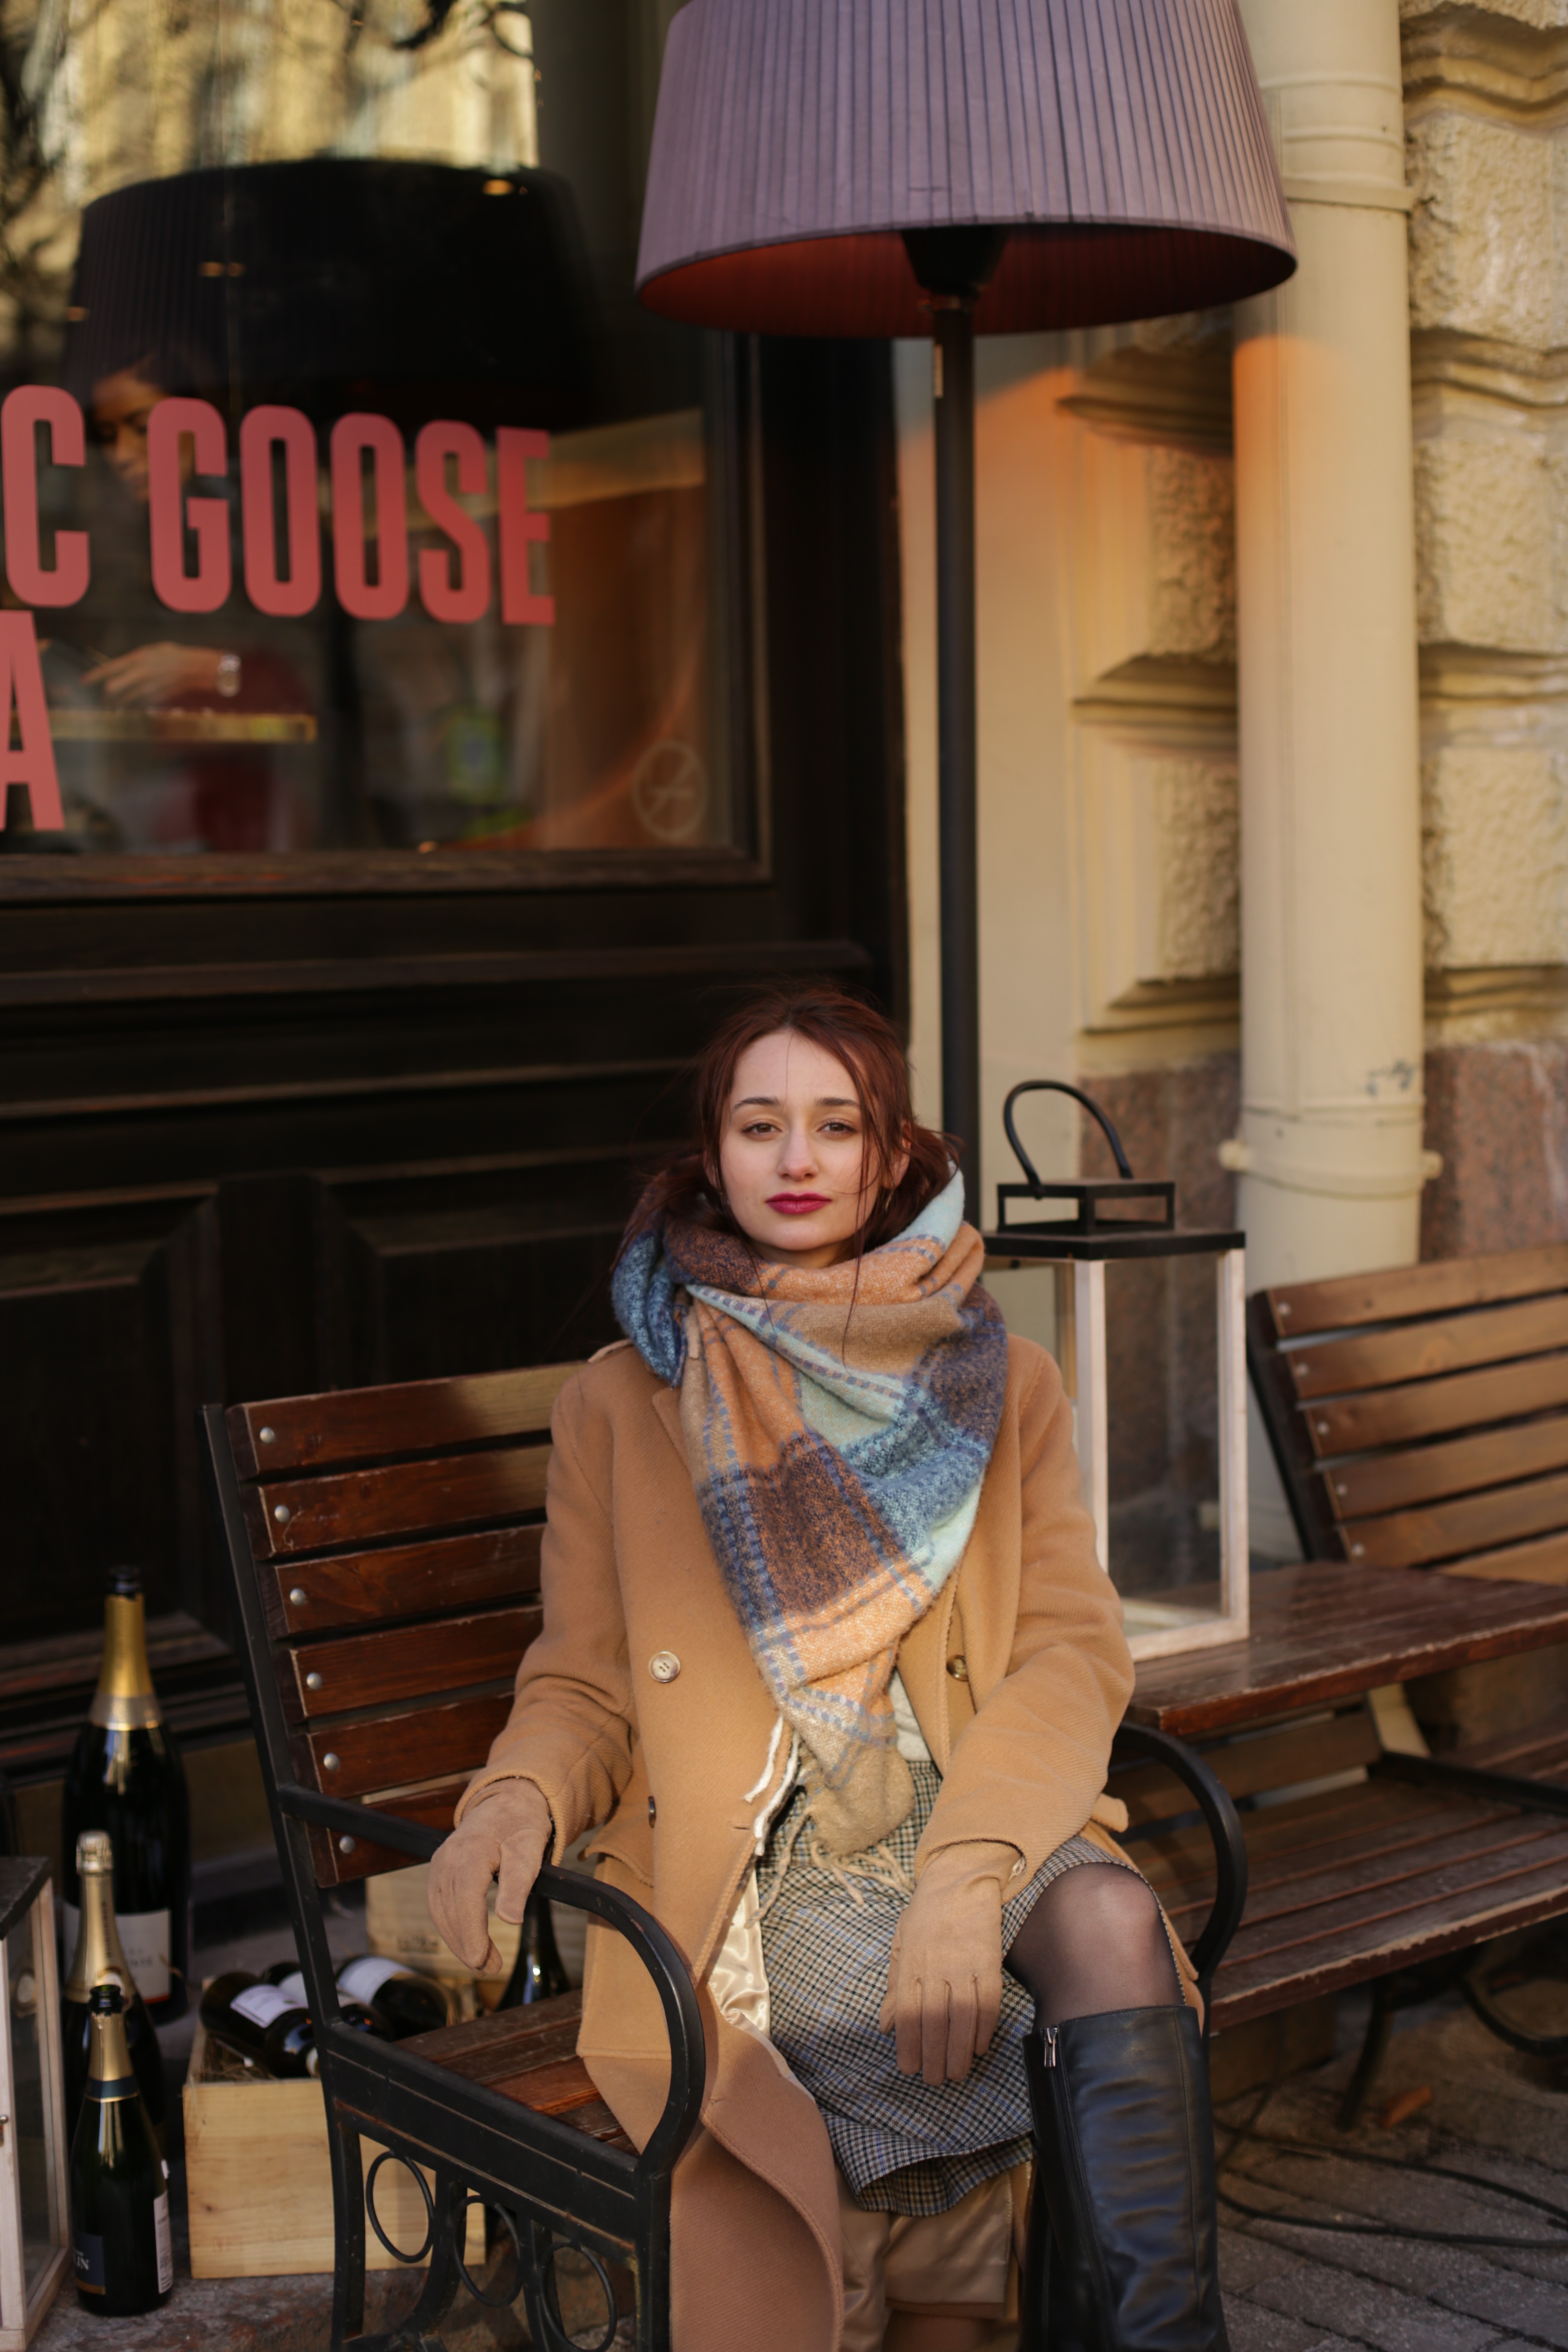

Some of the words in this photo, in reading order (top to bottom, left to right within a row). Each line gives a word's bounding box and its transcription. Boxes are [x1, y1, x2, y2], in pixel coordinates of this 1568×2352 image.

[1, 385, 89, 607] C
[147, 397, 555, 625] GOOSE
[0, 610, 64, 830] A
